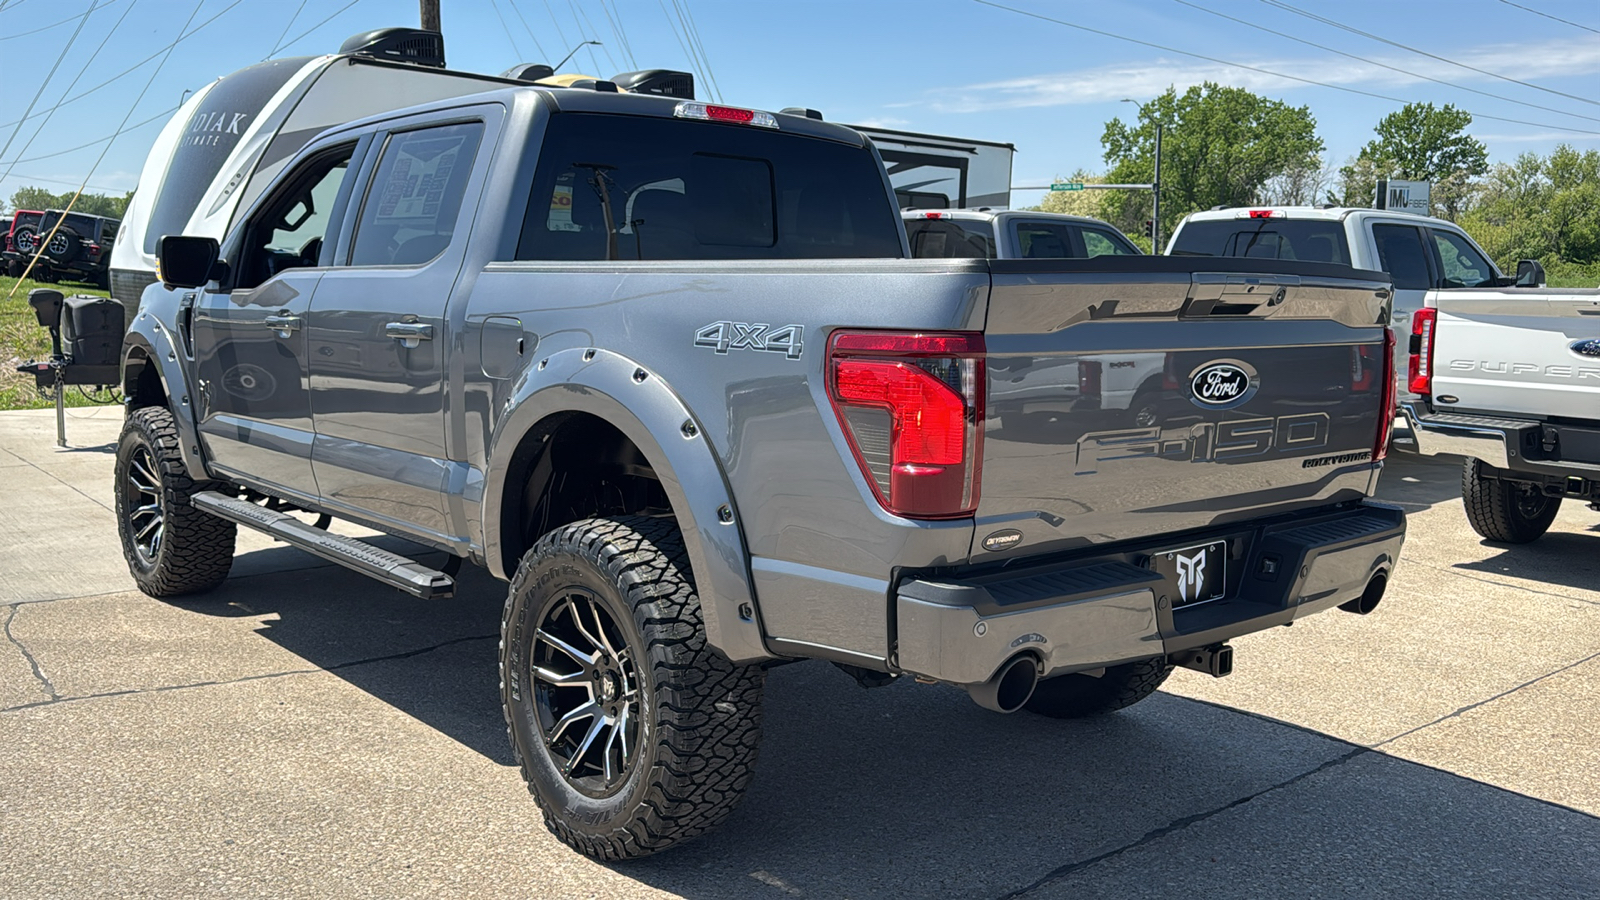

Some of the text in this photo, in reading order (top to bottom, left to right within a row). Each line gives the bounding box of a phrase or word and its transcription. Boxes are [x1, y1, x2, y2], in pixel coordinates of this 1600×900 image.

[188, 112, 247, 135] DIAK
[1389, 189, 1410, 208] IMU
[1450, 359, 1600, 380] SUPER
[1203, 370, 1241, 397] Ford
[1075, 412, 1330, 476] F-150
